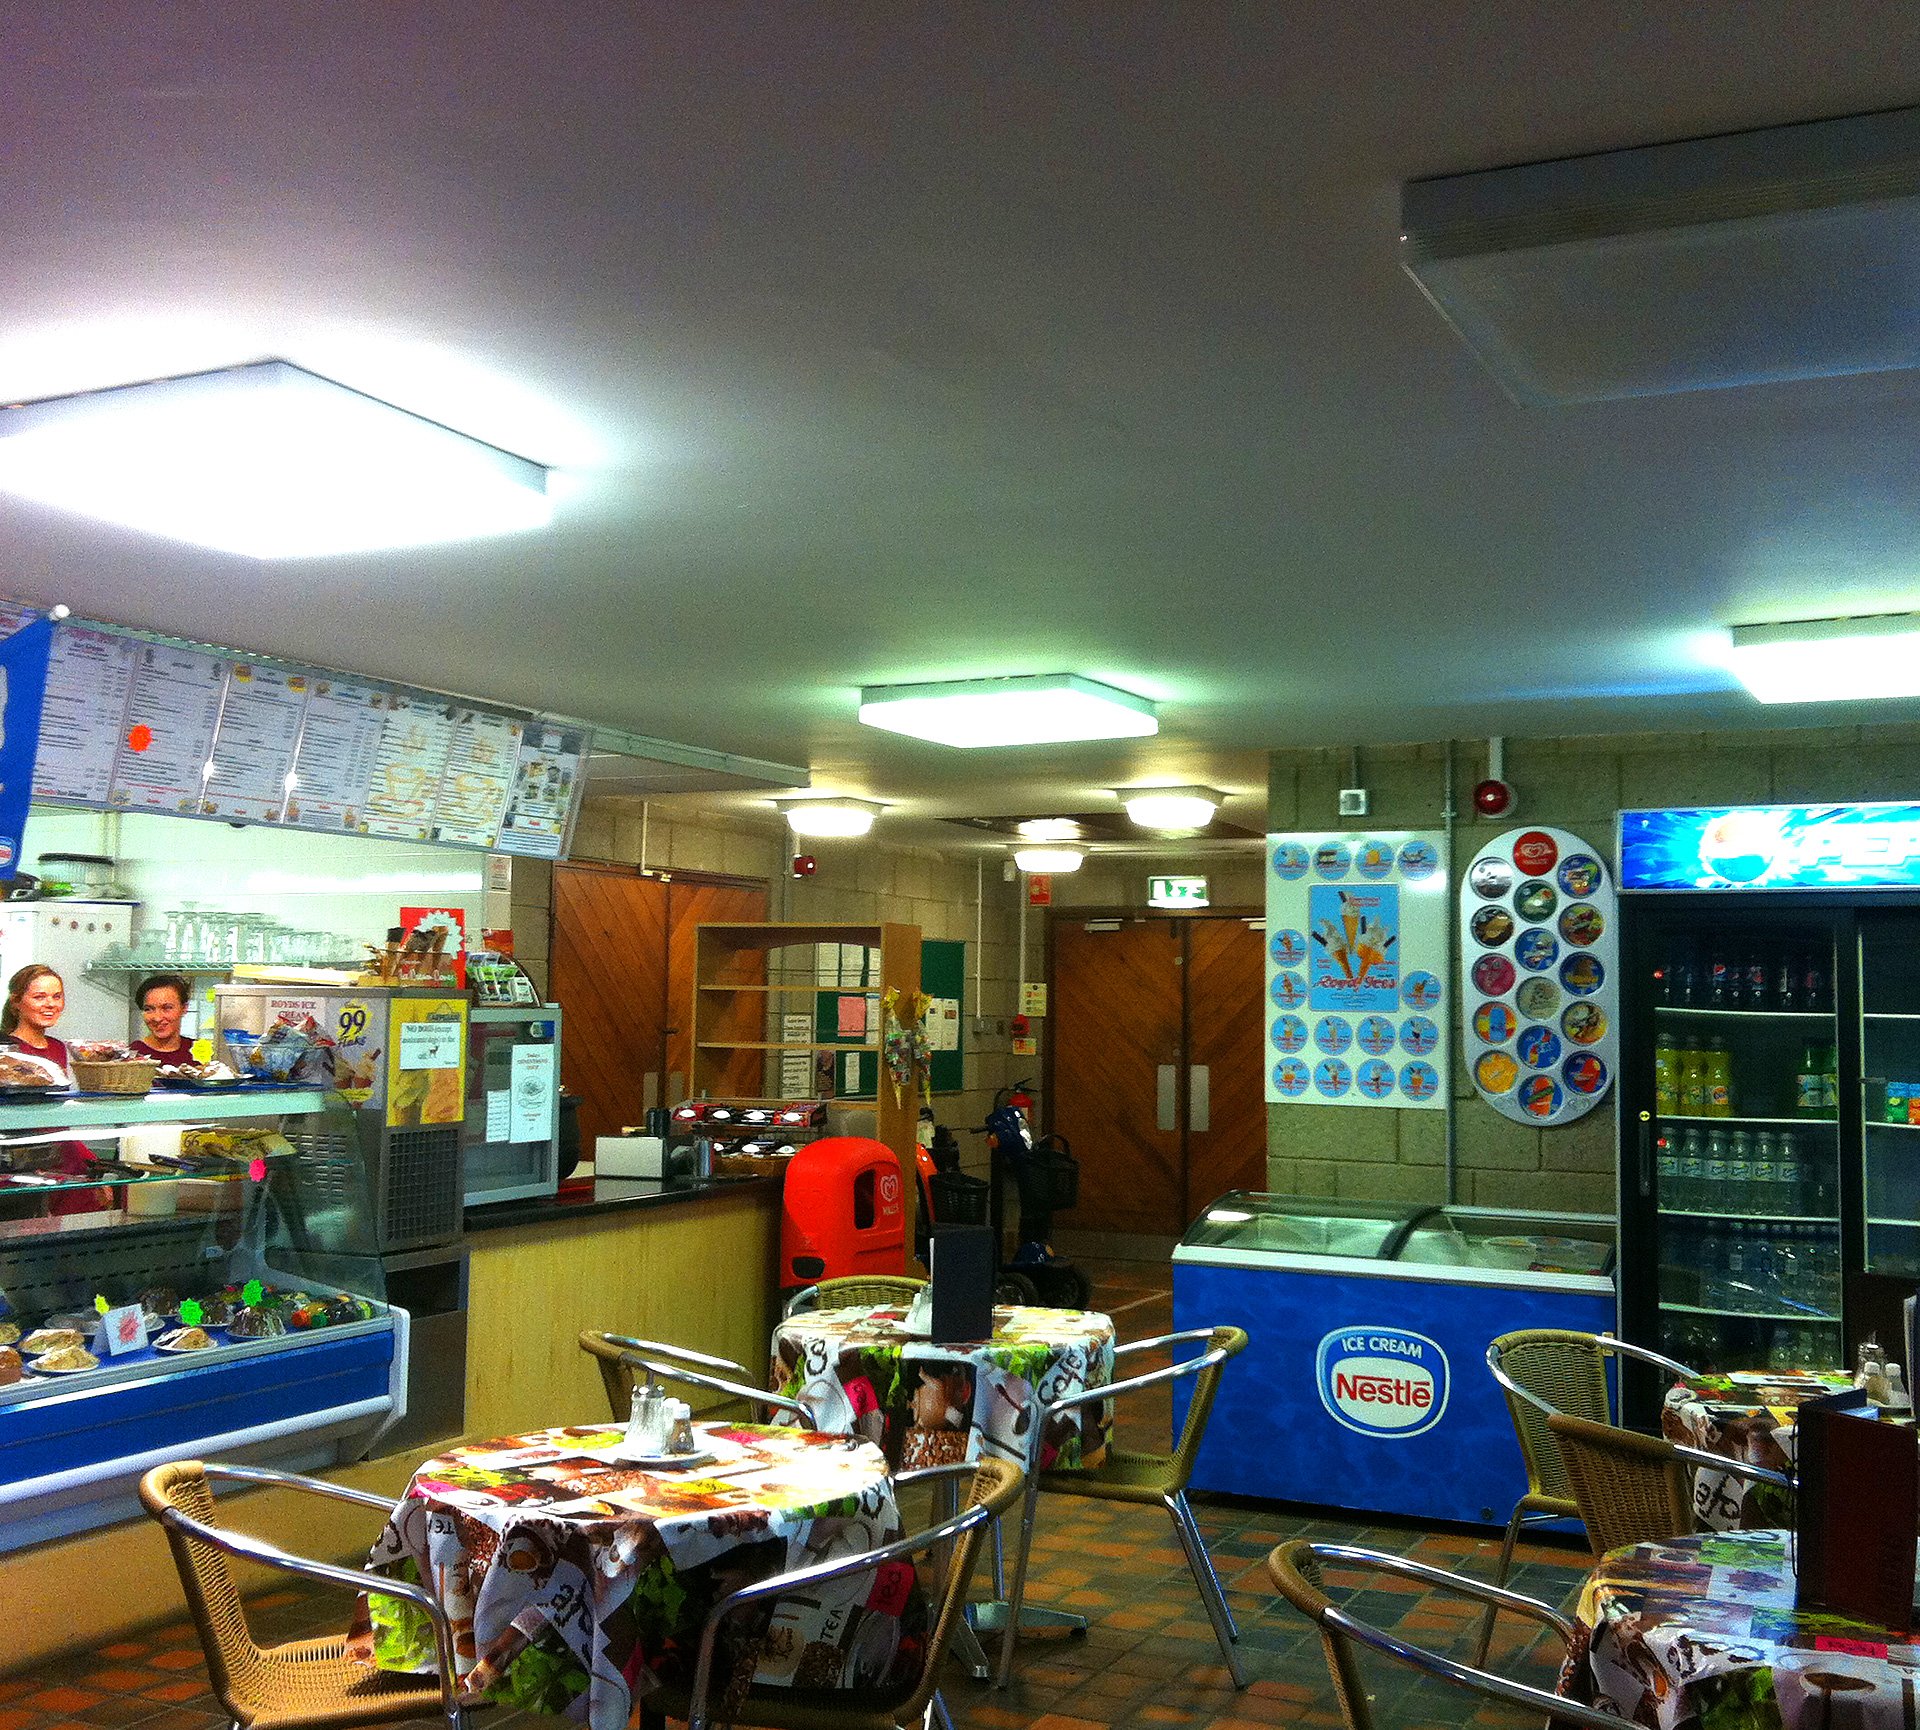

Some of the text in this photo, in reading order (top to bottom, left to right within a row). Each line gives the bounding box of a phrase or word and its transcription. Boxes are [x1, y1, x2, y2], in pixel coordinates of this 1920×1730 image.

[339, 1009, 367, 1037] 99
[1341, 1336, 1423, 1359] ICE CREAM
[1335, 1372, 1431, 1409] Nestlé
